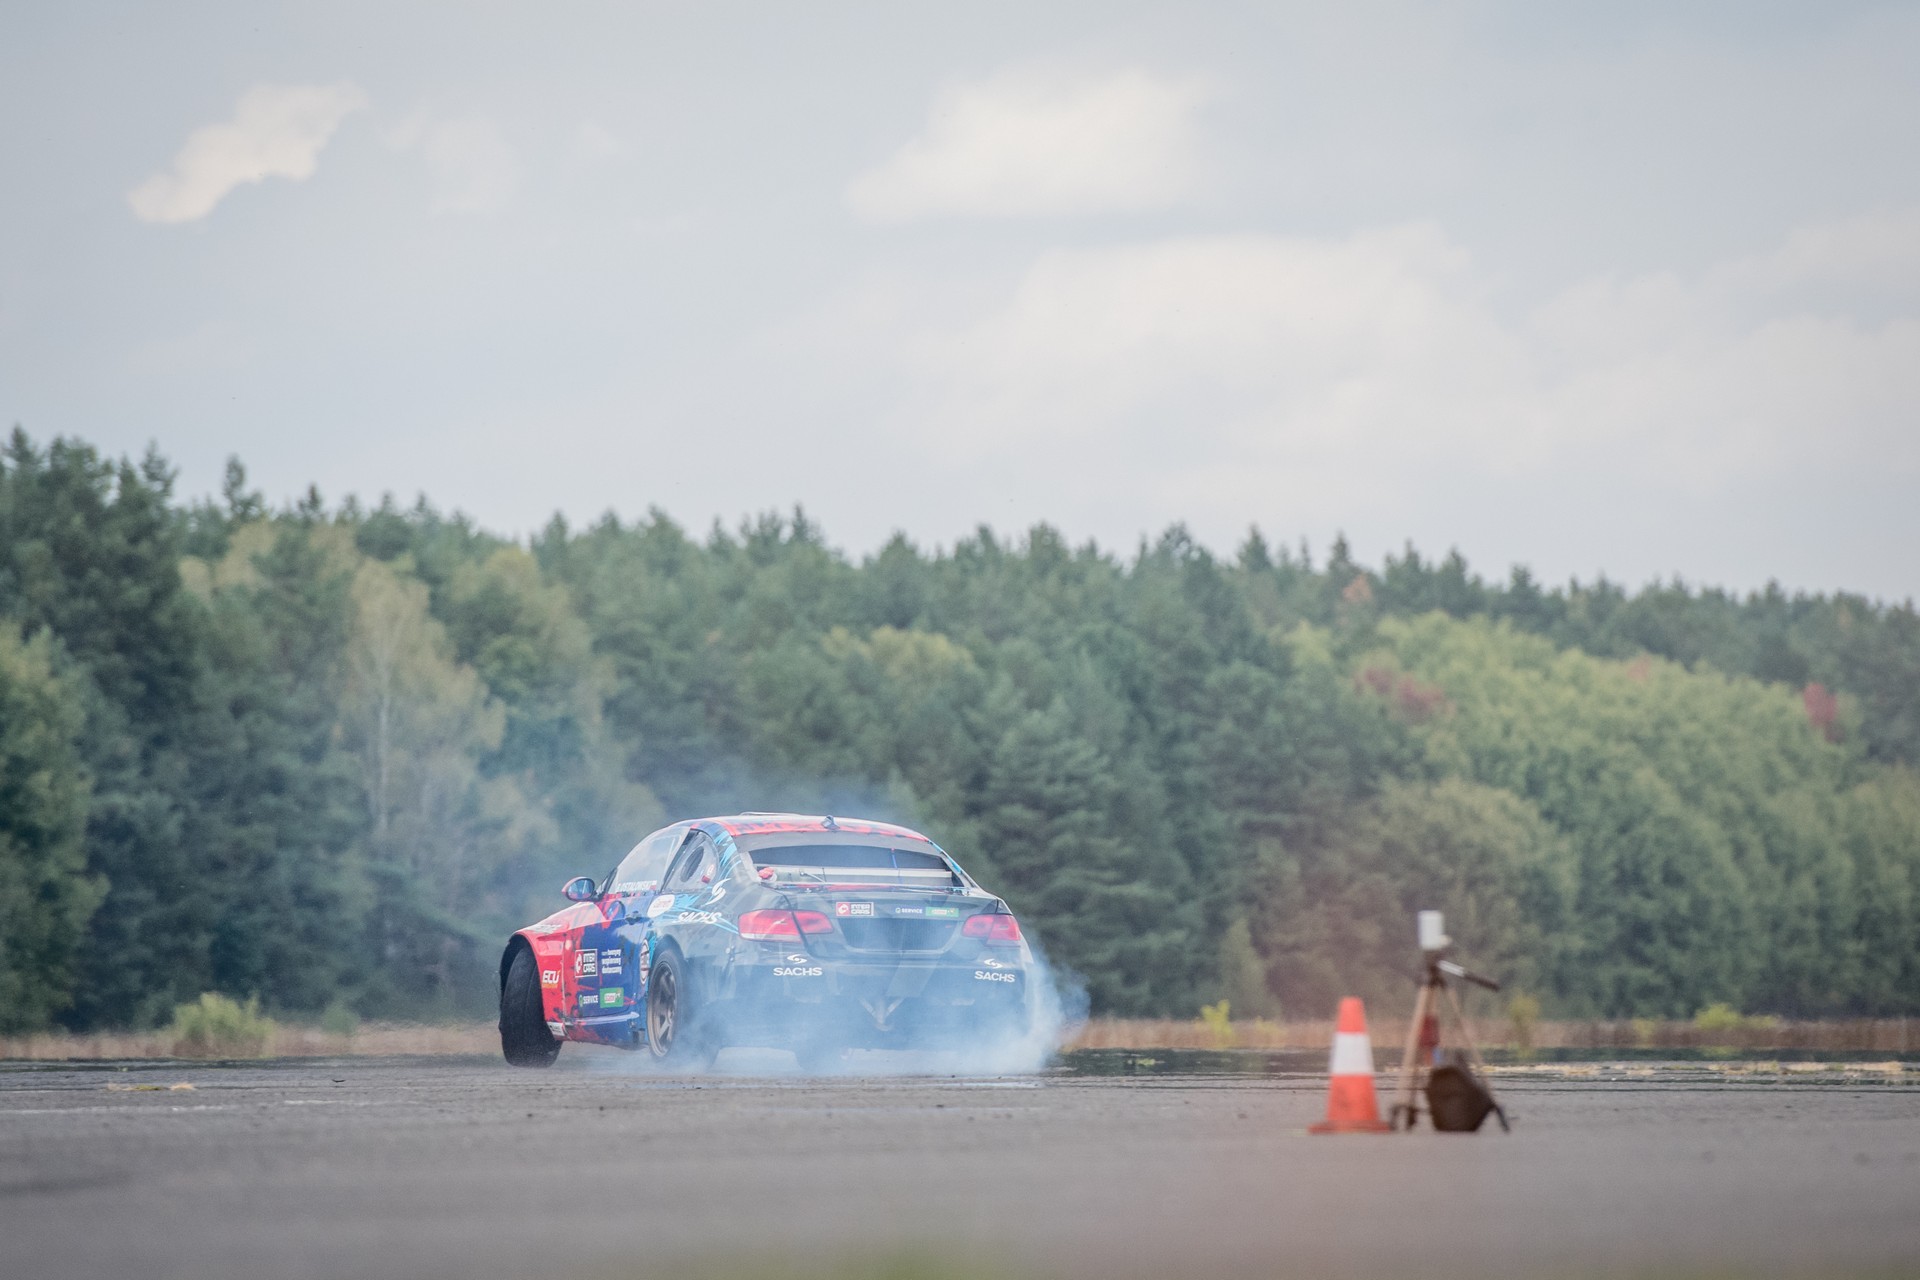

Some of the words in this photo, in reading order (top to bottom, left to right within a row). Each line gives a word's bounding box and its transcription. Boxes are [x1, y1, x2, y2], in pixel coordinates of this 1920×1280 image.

[671, 911, 722, 924] SACHS
[583, 952, 596, 962] INTER
[583, 963, 596, 973] CARS
[773, 967, 823, 976] SACHS
[542, 969, 560, 984] ECU
[974, 970, 1016, 983] SACHS
[583, 995, 599, 1004] SERVICE
